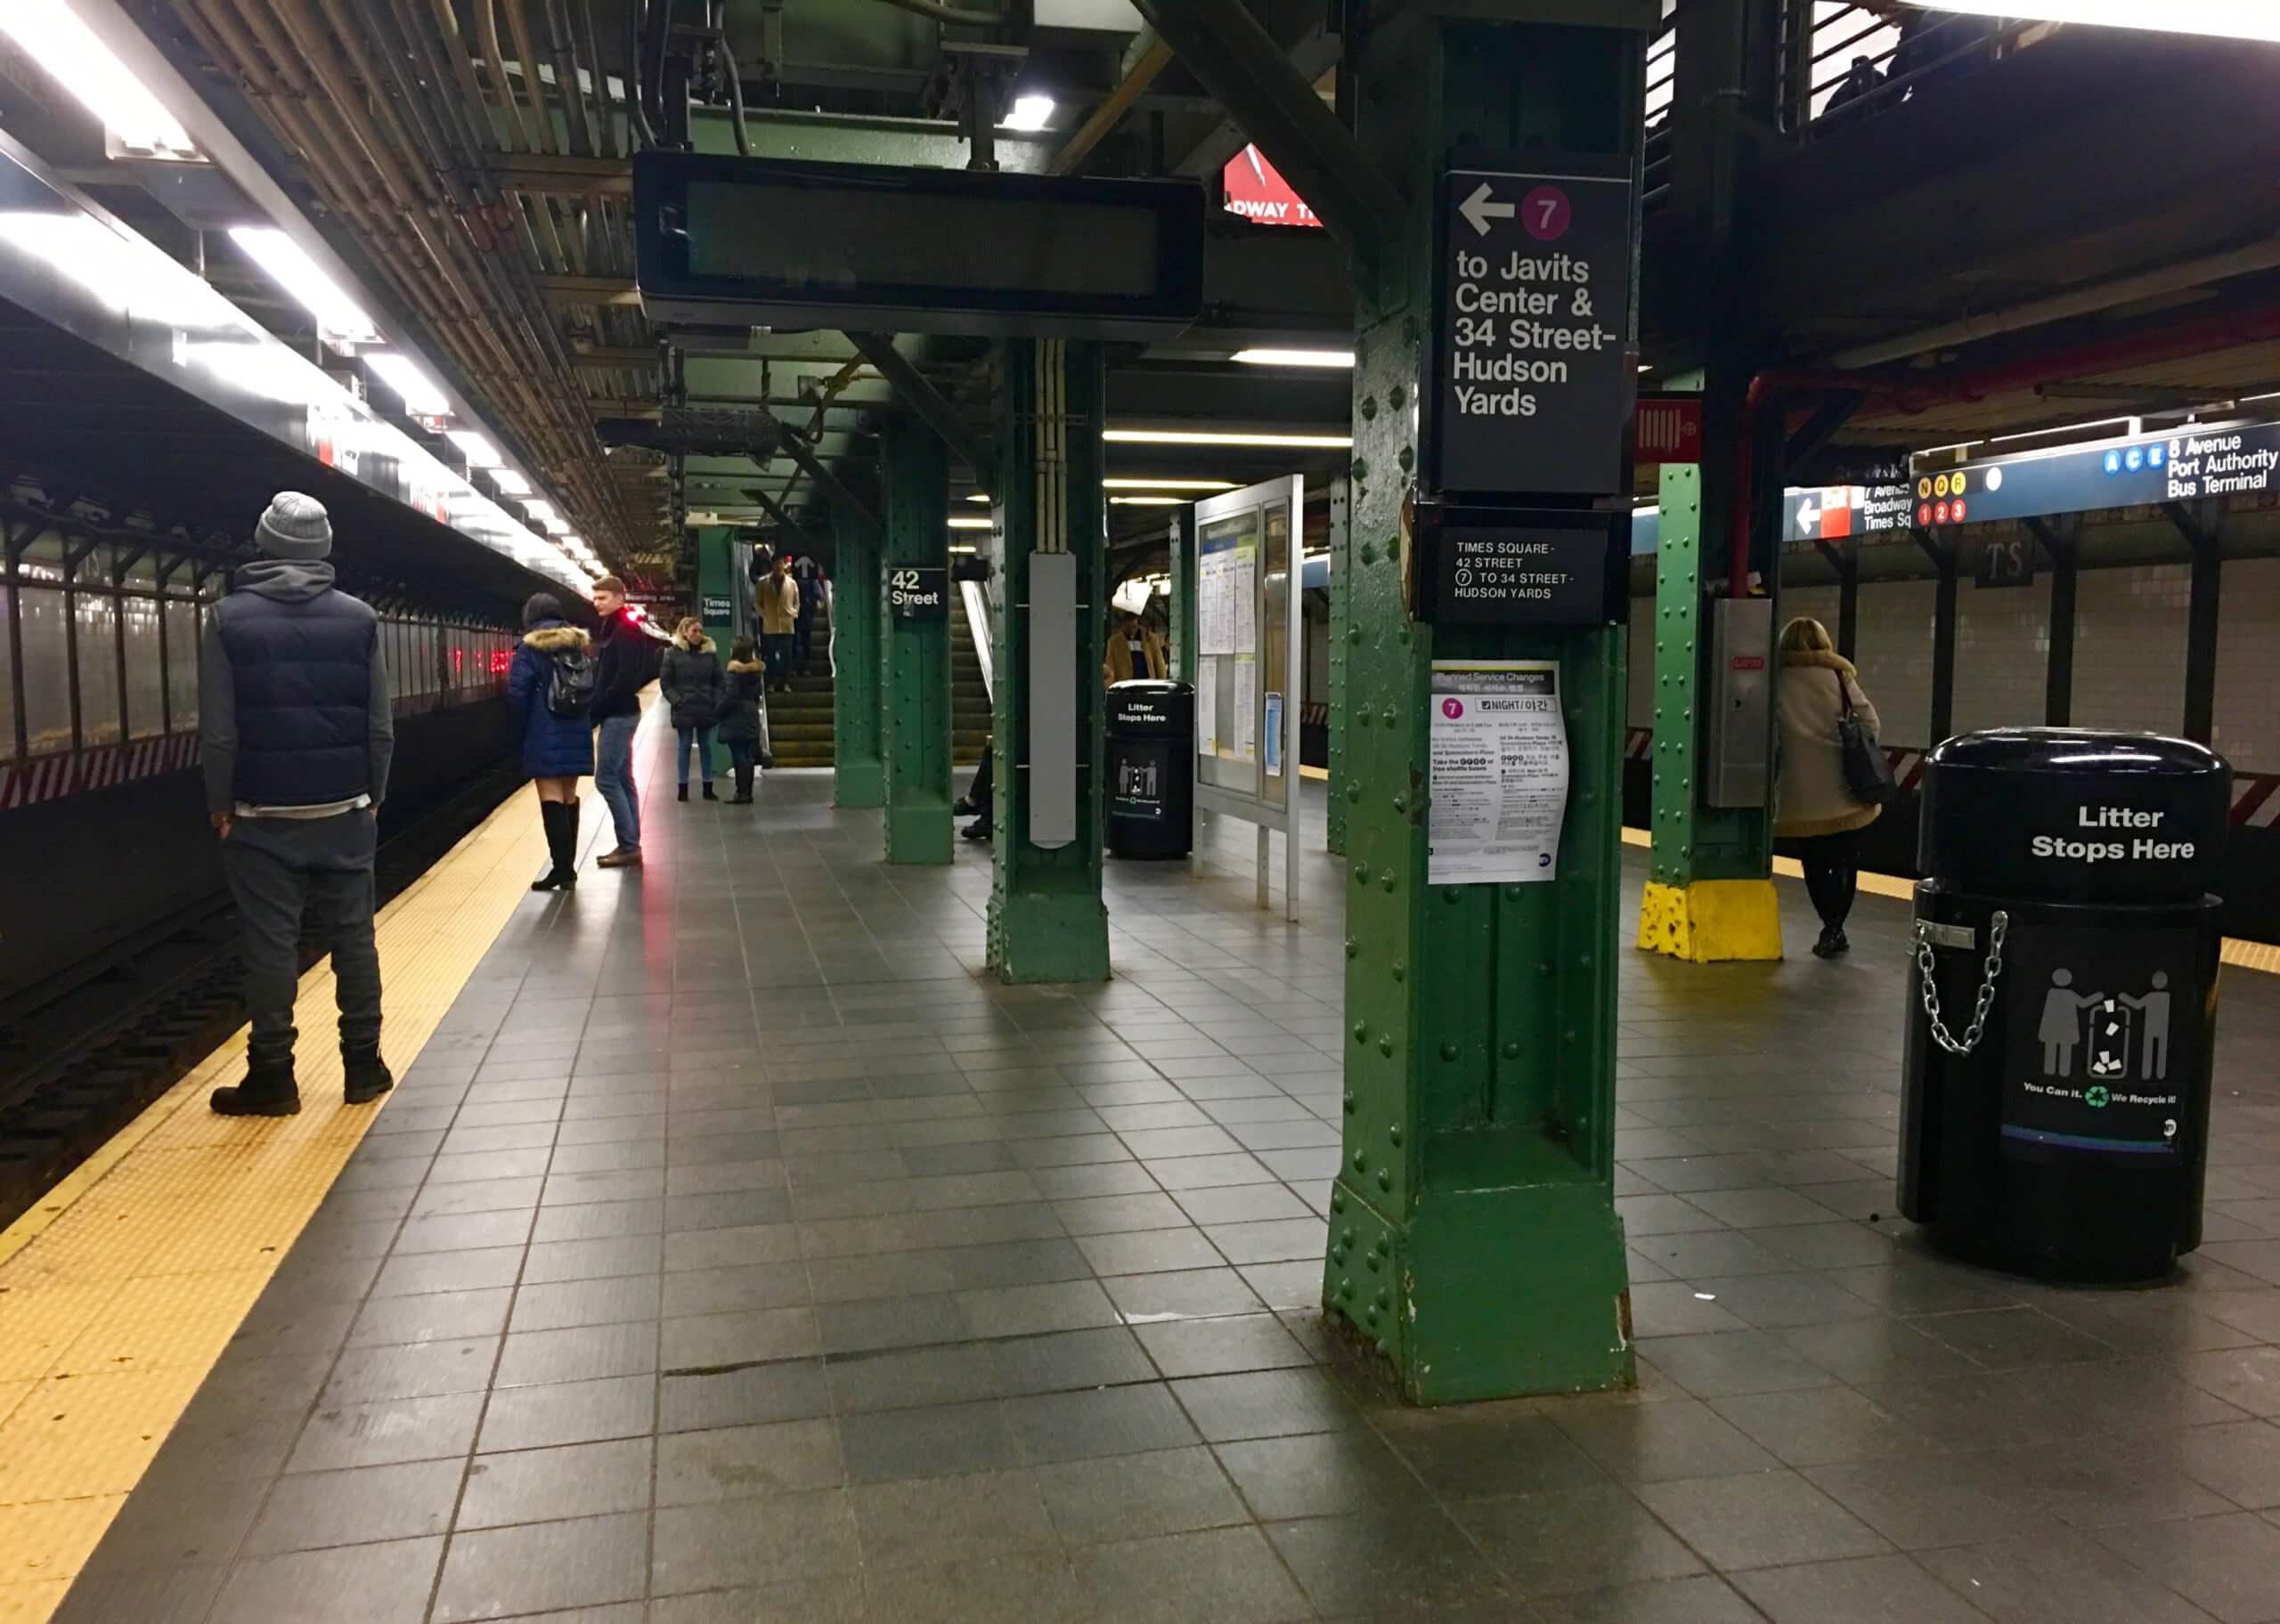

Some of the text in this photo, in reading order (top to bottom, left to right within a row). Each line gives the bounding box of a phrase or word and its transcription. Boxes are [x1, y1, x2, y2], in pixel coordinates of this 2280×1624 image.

[1536, 199, 1557, 229] 7
[1456, 250, 1590, 283] to Javits
[1455, 283, 1592, 317] Center &
[1454, 317, 1616, 351] 34 Street-
[1454, 352, 1568, 383] Hudson
[1454, 386, 1536, 417] Yards
[2168, 434, 2242, 459] 8 Avenue
[2168, 449, 2279, 478] Port Authority
[2168, 469, 2268, 499] Bus Terminal
[1864, 498, 1913, 515] Broadway
[1864, 512, 1912, 531] Times Sq
[1457, 541, 1494, 553] TIMES
[1455, 557, 1523, 568] 42 STREET
[1985, 540, 2023, 580] TS
[892, 570, 920, 589] 42
[1479, 572, 1497, 583] TO
[1501, 572, 1515, 584] 34
[704, 597, 730, 607] Times
[892, 590, 939, 605] Street
[1454, 588, 1551, 599] HUDSON YARDS
[704, 607, 730, 616] Square
[1474, 672, 1505, 682] Service
[1506, 672, 1545, 683] Changes
[1128, 702, 1154, 711] Litter
[1118, 713, 1167, 723] Stops Here
[2078, 805, 2164, 828] Litter
[2032, 835, 2195, 863] Stops Here
[2024, 1082, 2044, 1093] You
[2046, 1086, 2069, 1097] Can
[2111, 1093, 2128, 1102] We
[2129, 1094, 2166, 1106] Recycle
